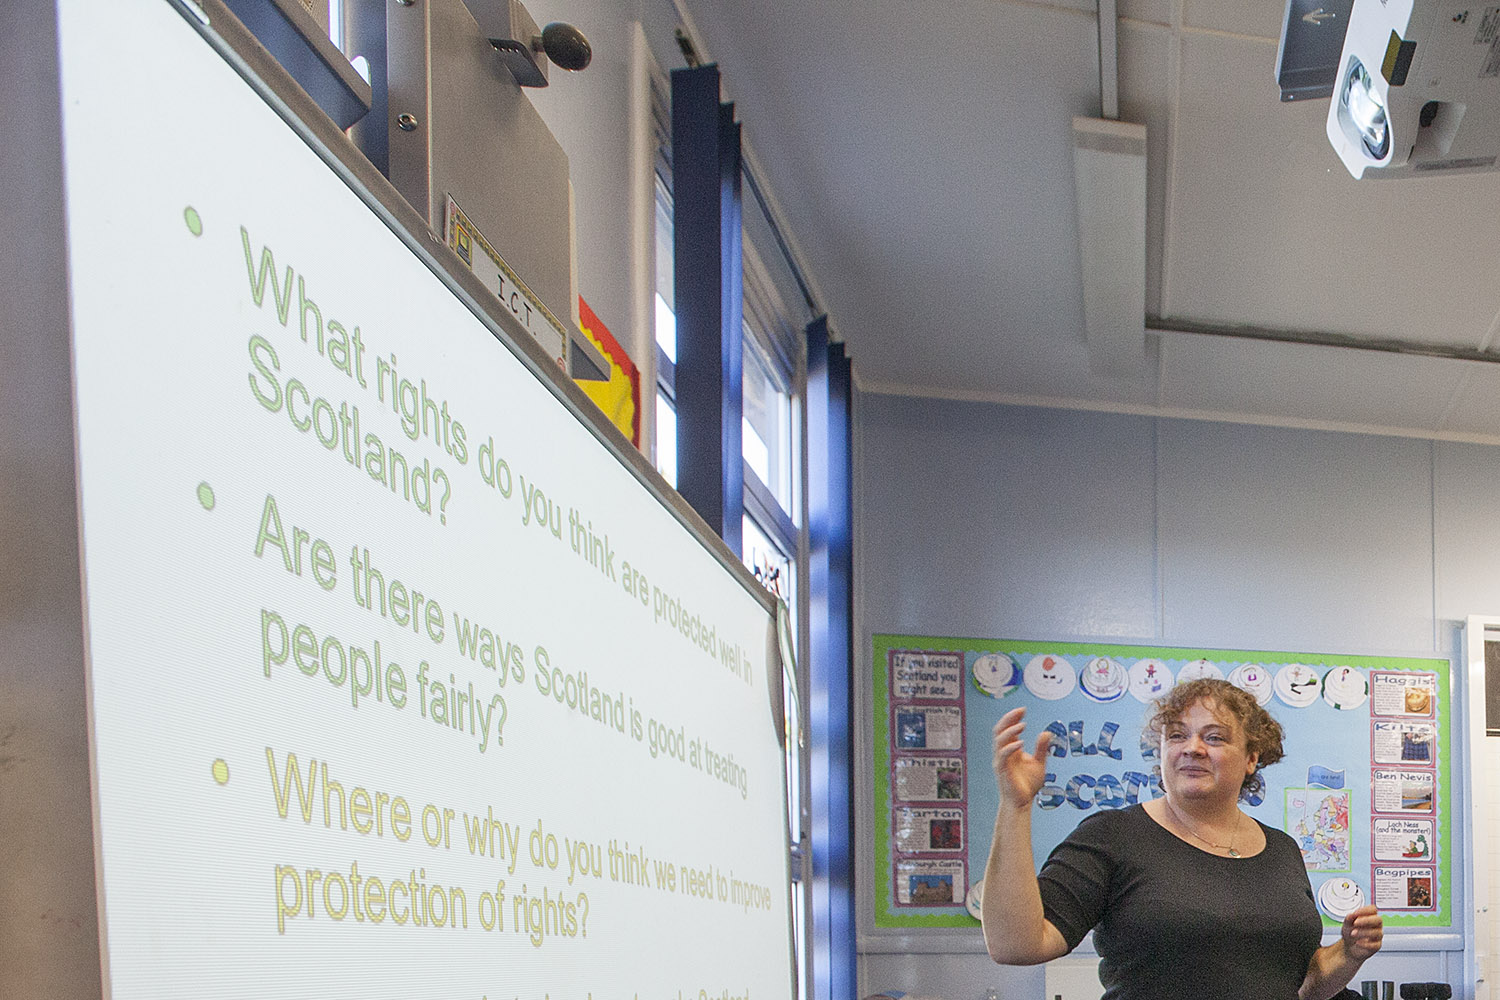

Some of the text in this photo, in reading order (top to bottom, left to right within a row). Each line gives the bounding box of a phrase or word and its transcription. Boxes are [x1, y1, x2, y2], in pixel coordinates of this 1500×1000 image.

[240, 225, 753, 687] What rights do you think are protected well in
[248, 333, 451, 527] Scotland?
[255, 493, 748, 800] Are there ways Scotland is good at treating
[260, 608, 508, 753] people fairly?
[1375, 676, 1430, 685] Haggis
[1042, 720, 1122, 761] ALL
[265, 746, 772, 914] Where or why do you think we need to improve
[1376, 869, 1431, 877] Bagpipes
[274, 860, 590, 948] protection of rights?
